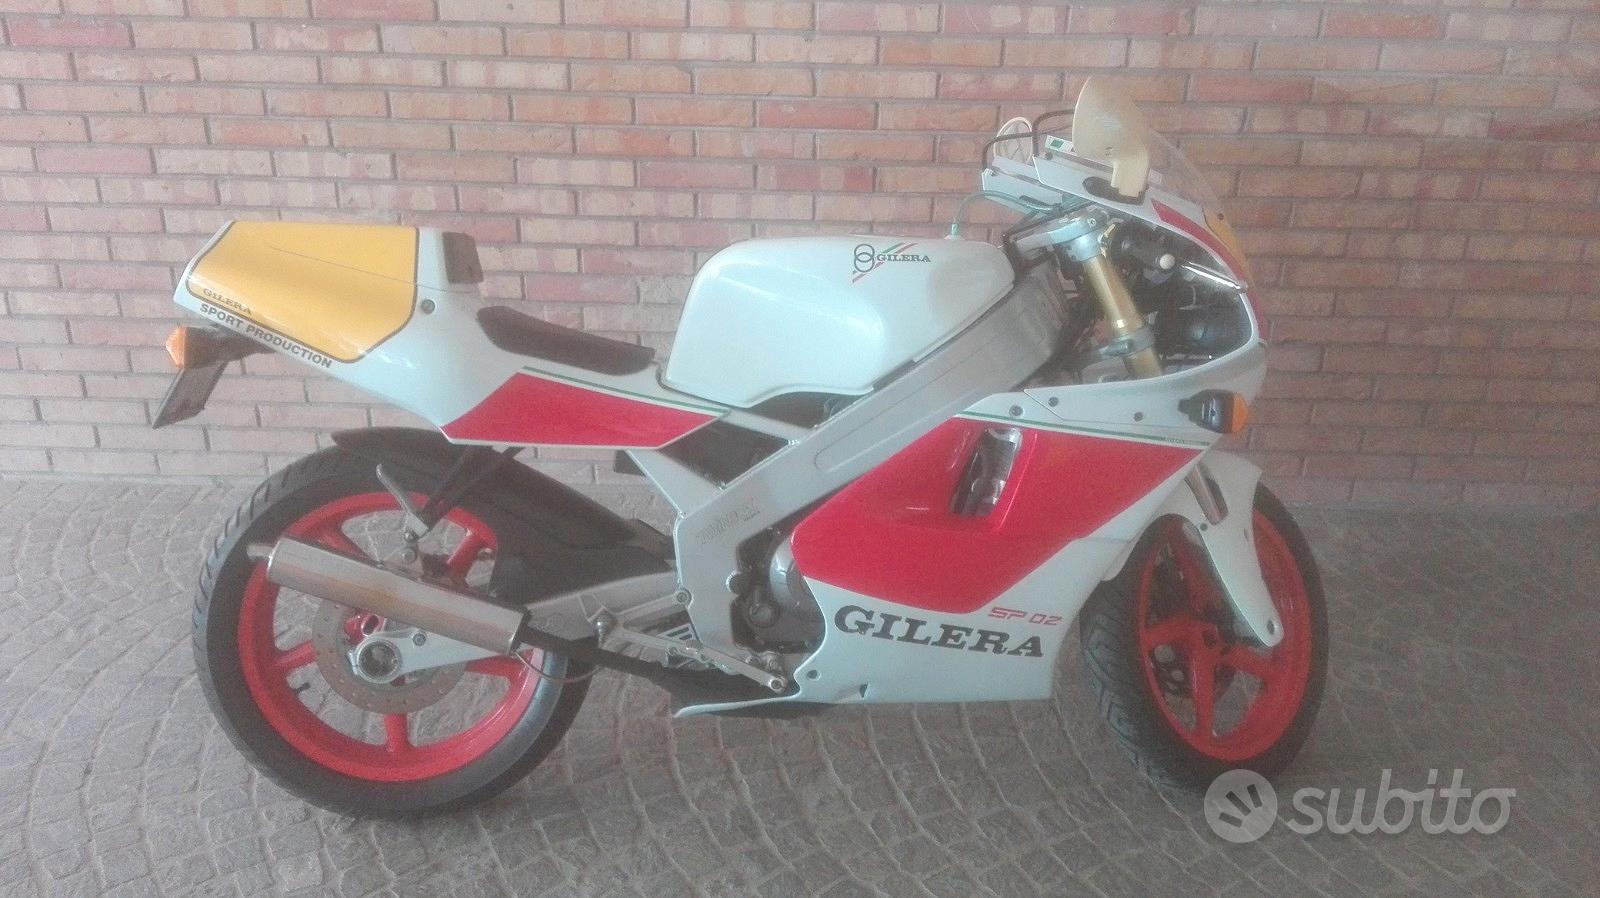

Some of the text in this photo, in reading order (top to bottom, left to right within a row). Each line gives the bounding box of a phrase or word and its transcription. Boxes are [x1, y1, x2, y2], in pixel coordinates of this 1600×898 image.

[876, 253, 932, 263] GILERA
[202, 288, 252, 316] GILERA
[200, 303, 333, 368] SPORT PRODUCTION
[988, 606, 1063, 626] SP 02
[834, 604, 1045, 657] GILERA
